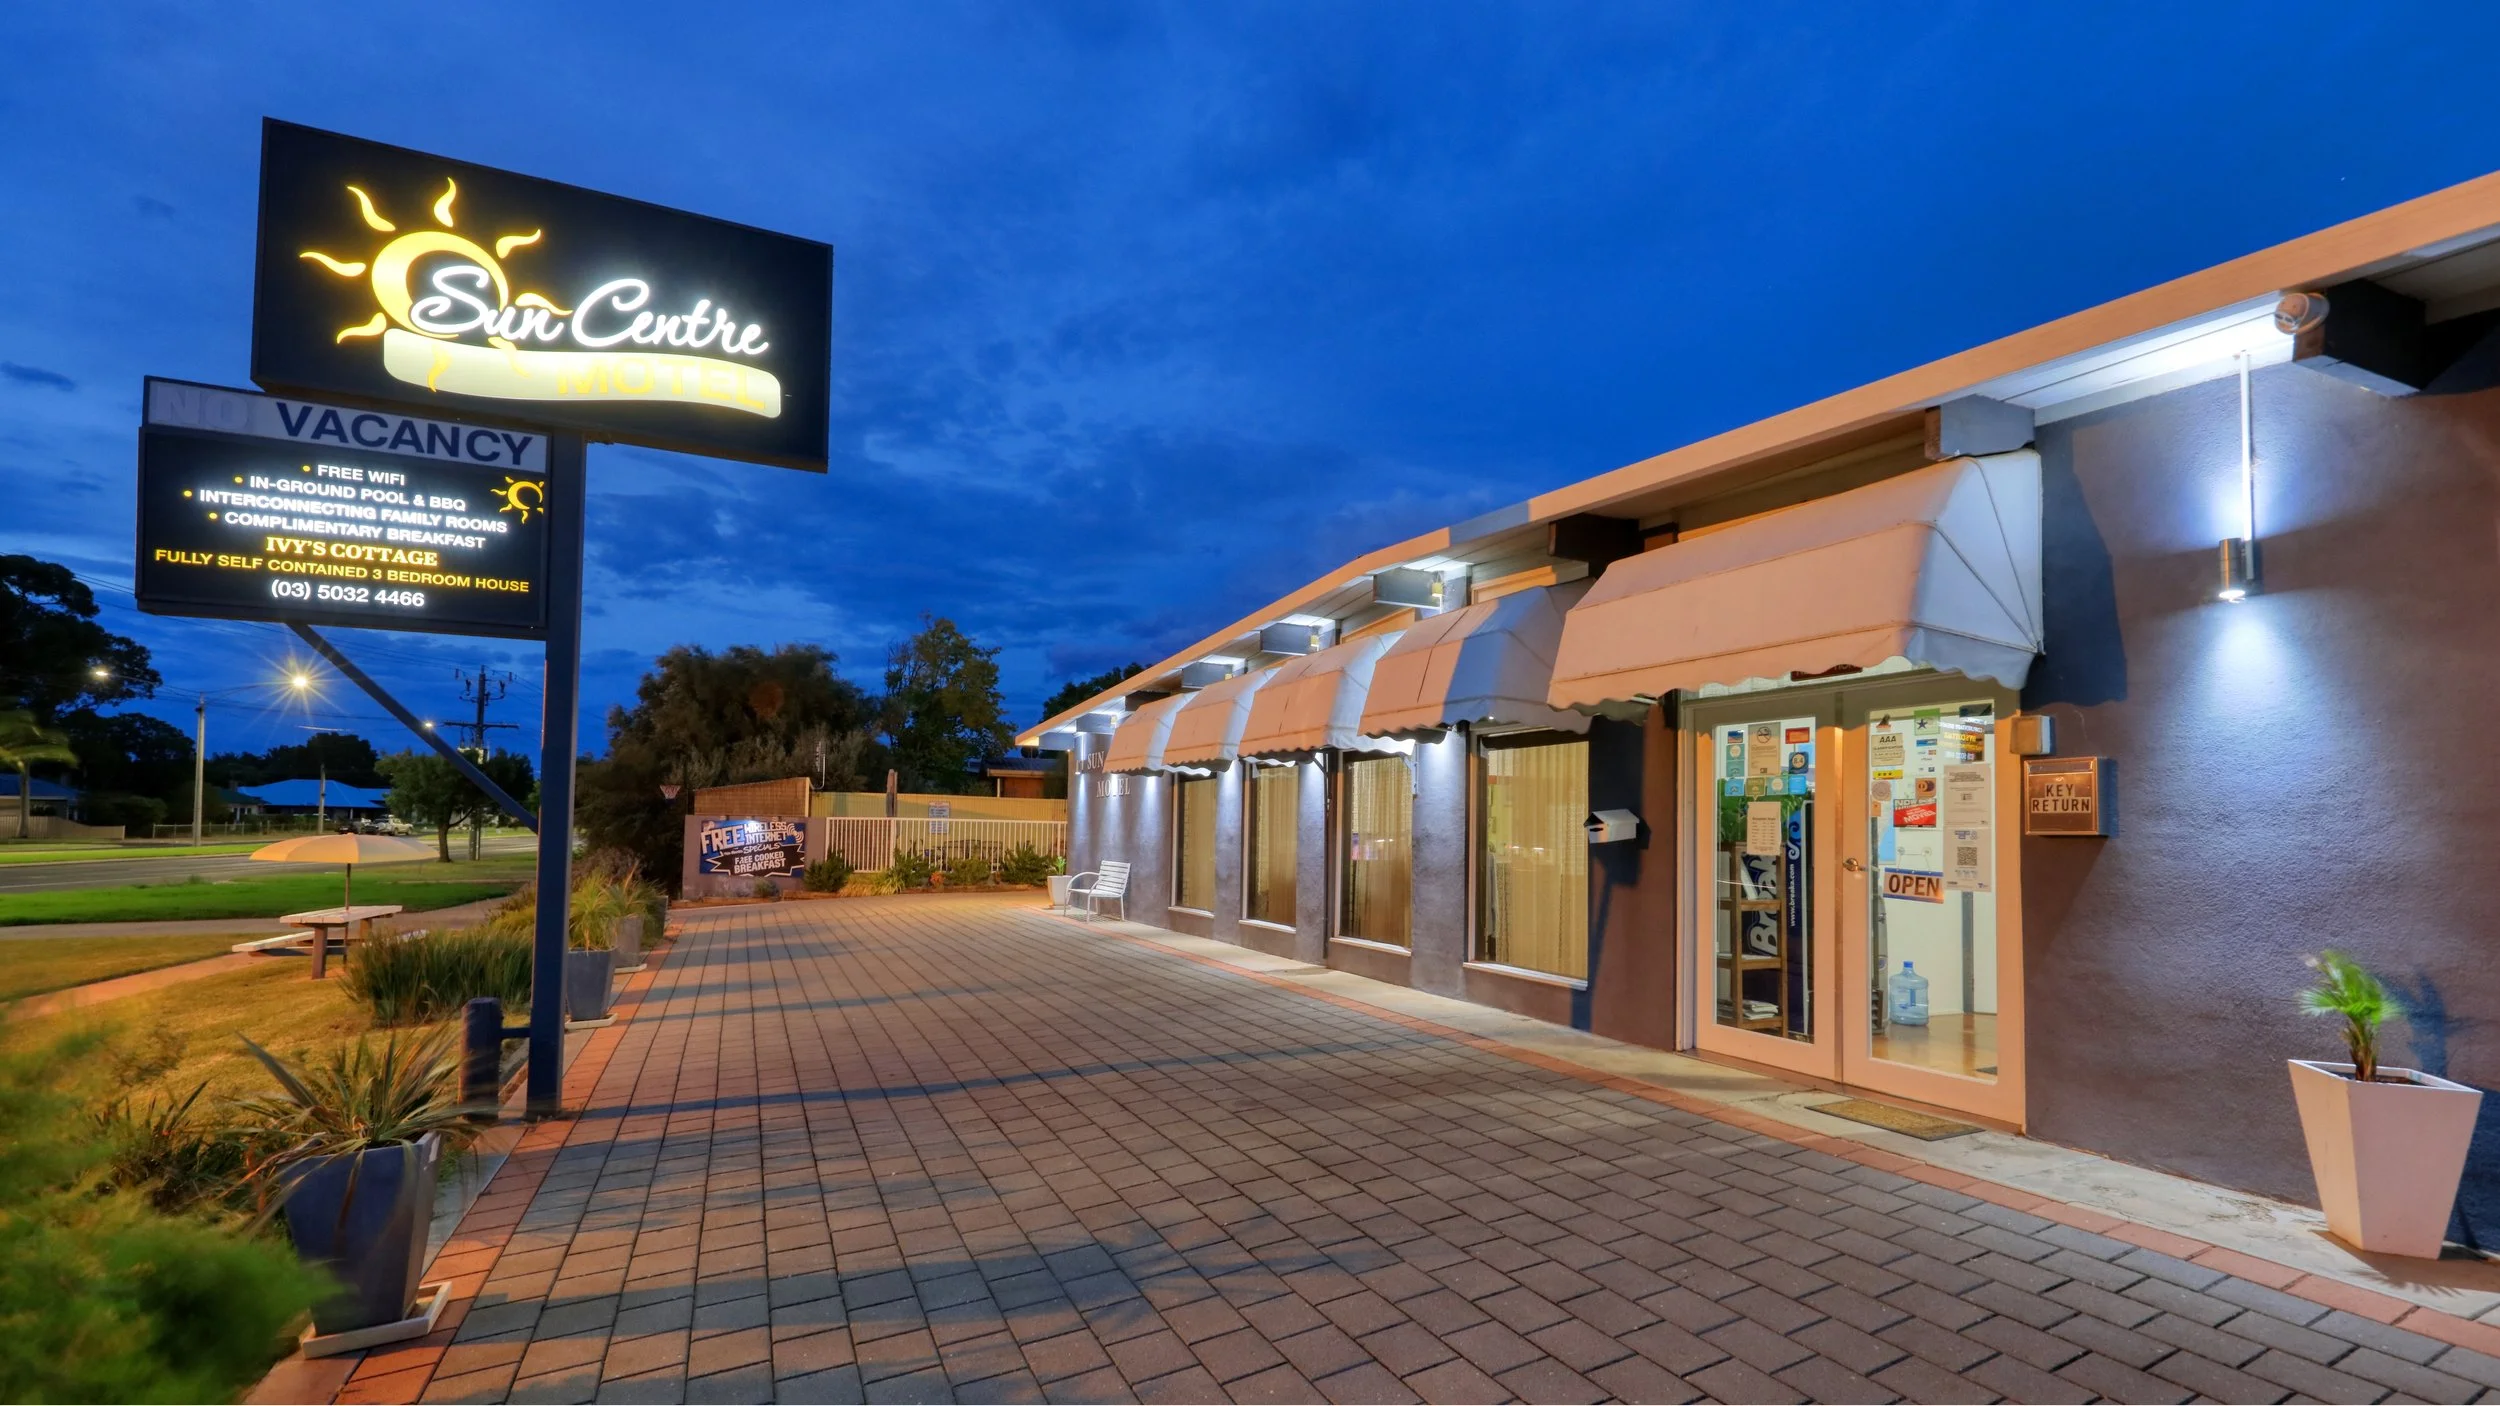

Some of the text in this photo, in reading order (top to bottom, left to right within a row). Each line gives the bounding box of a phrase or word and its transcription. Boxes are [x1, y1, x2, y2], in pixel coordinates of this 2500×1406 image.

[410, 265, 769, 355] Sun Centre
[556, 360, 766, 410] MOTEL
[276, 401, 533, 466] VACANCY
[317, 464, 405, 486] FREE WIFI
[250, 474, 467, 513] IN-GROUND POOL & BBQ
[199, 489, 508, 534] INTERCONNECTING FAMILY ROOMS
[224, 510, 486, 549] COMPLIMENTARY BREAKFAST
[265, 536, 438, 568] IVY'S COTTAGE
[155, 548, 530, 593] FULLY SELF CONTAINED 3 BEDROOM HOUSE
[270, 579, 425, 607] (03) 5032 4466
[1879, 735, 1897, 743] AAA
[1087, 751, 1104, 770] SUN
[1096, 777, 1131, 798] MOEL
[2046, 784, 2074, 797] KEY
[2032, 799, 2090, 812] RETURN
[744, 821, 787, 833] WIRELESS
[745, 831, 787, 845] INTERNET
[700, 825, 745, 854] FREE
[734, 857, 753, 865] FREE
[754, 851, 785, 862] COOKED
[734, 858, 787, 874] BREAKFAST
[1888, 874, 1940, 897] OPEN
